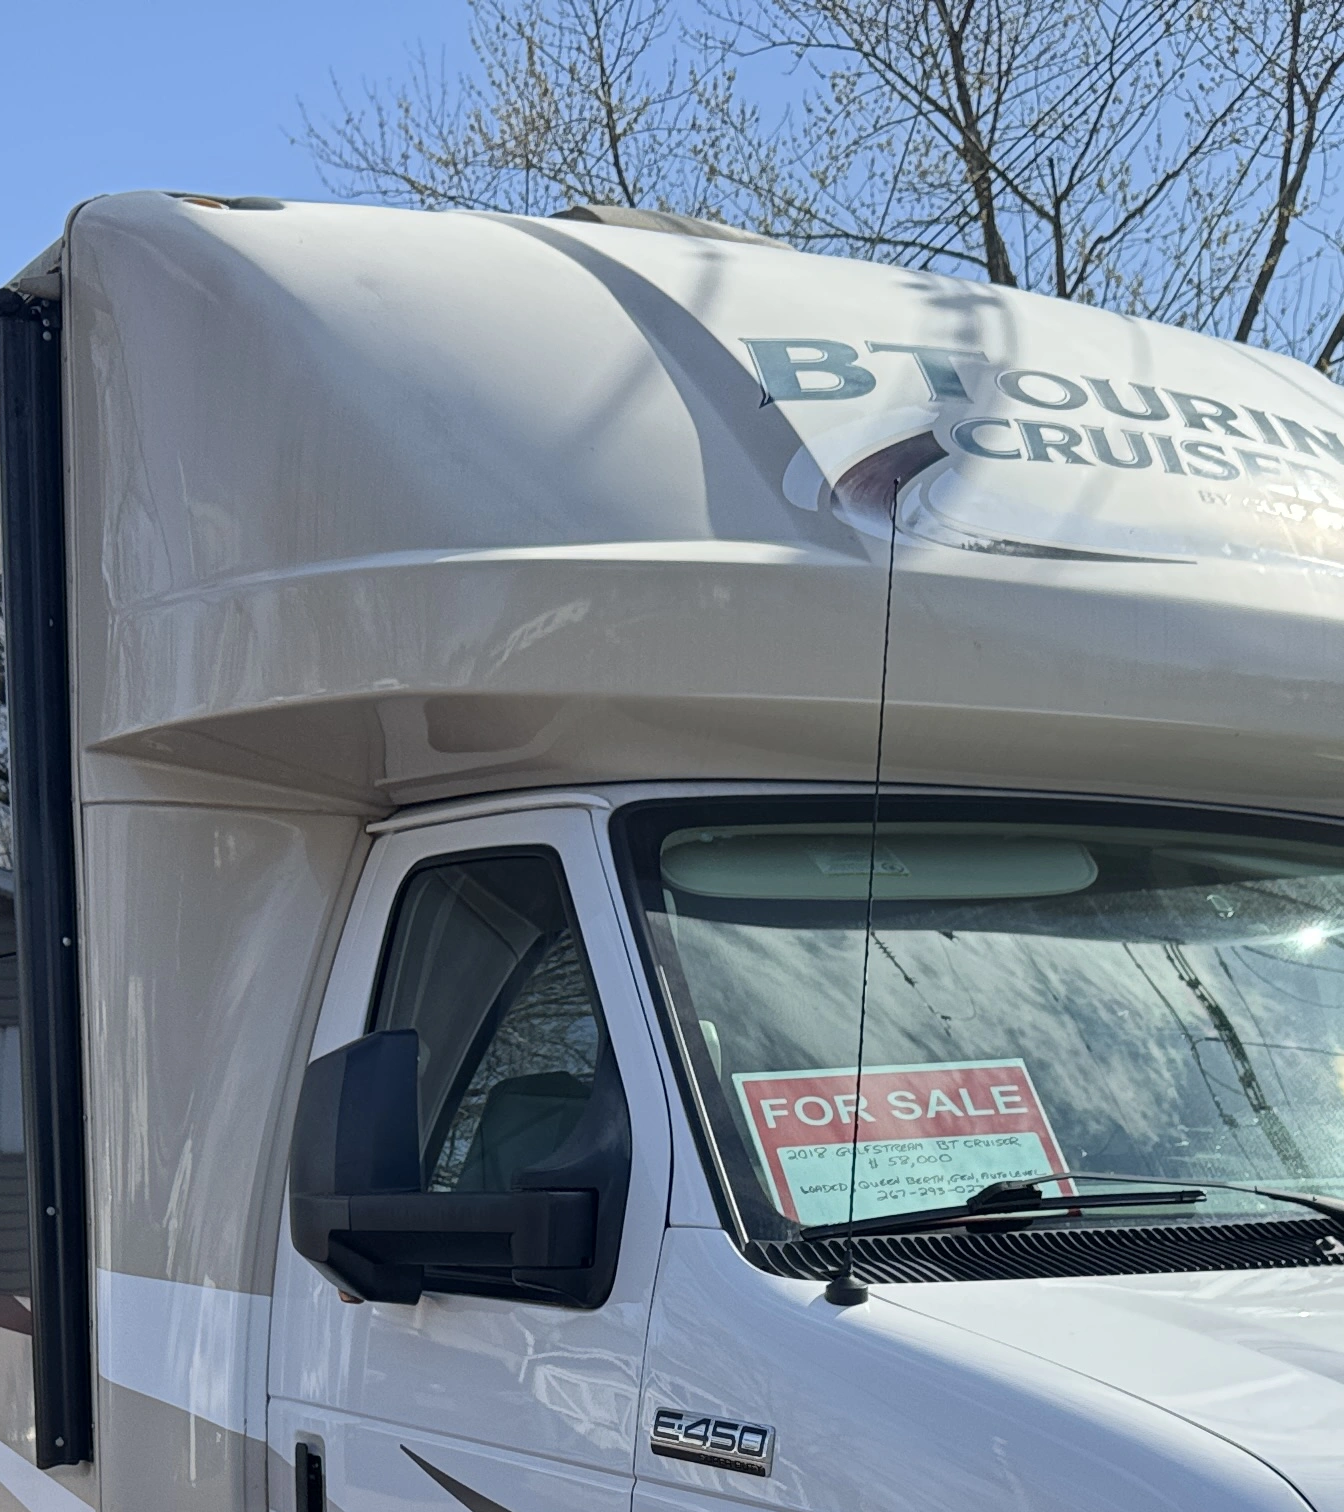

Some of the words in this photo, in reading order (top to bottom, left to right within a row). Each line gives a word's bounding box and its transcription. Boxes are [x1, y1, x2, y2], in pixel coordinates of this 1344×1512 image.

[759, 1093, 874, 1129] FOR
[887, 1085, 1030, 1121] SALE
[786, 1146, 828, 1161] 2018
[936, 1139, 960, 1151] BT
